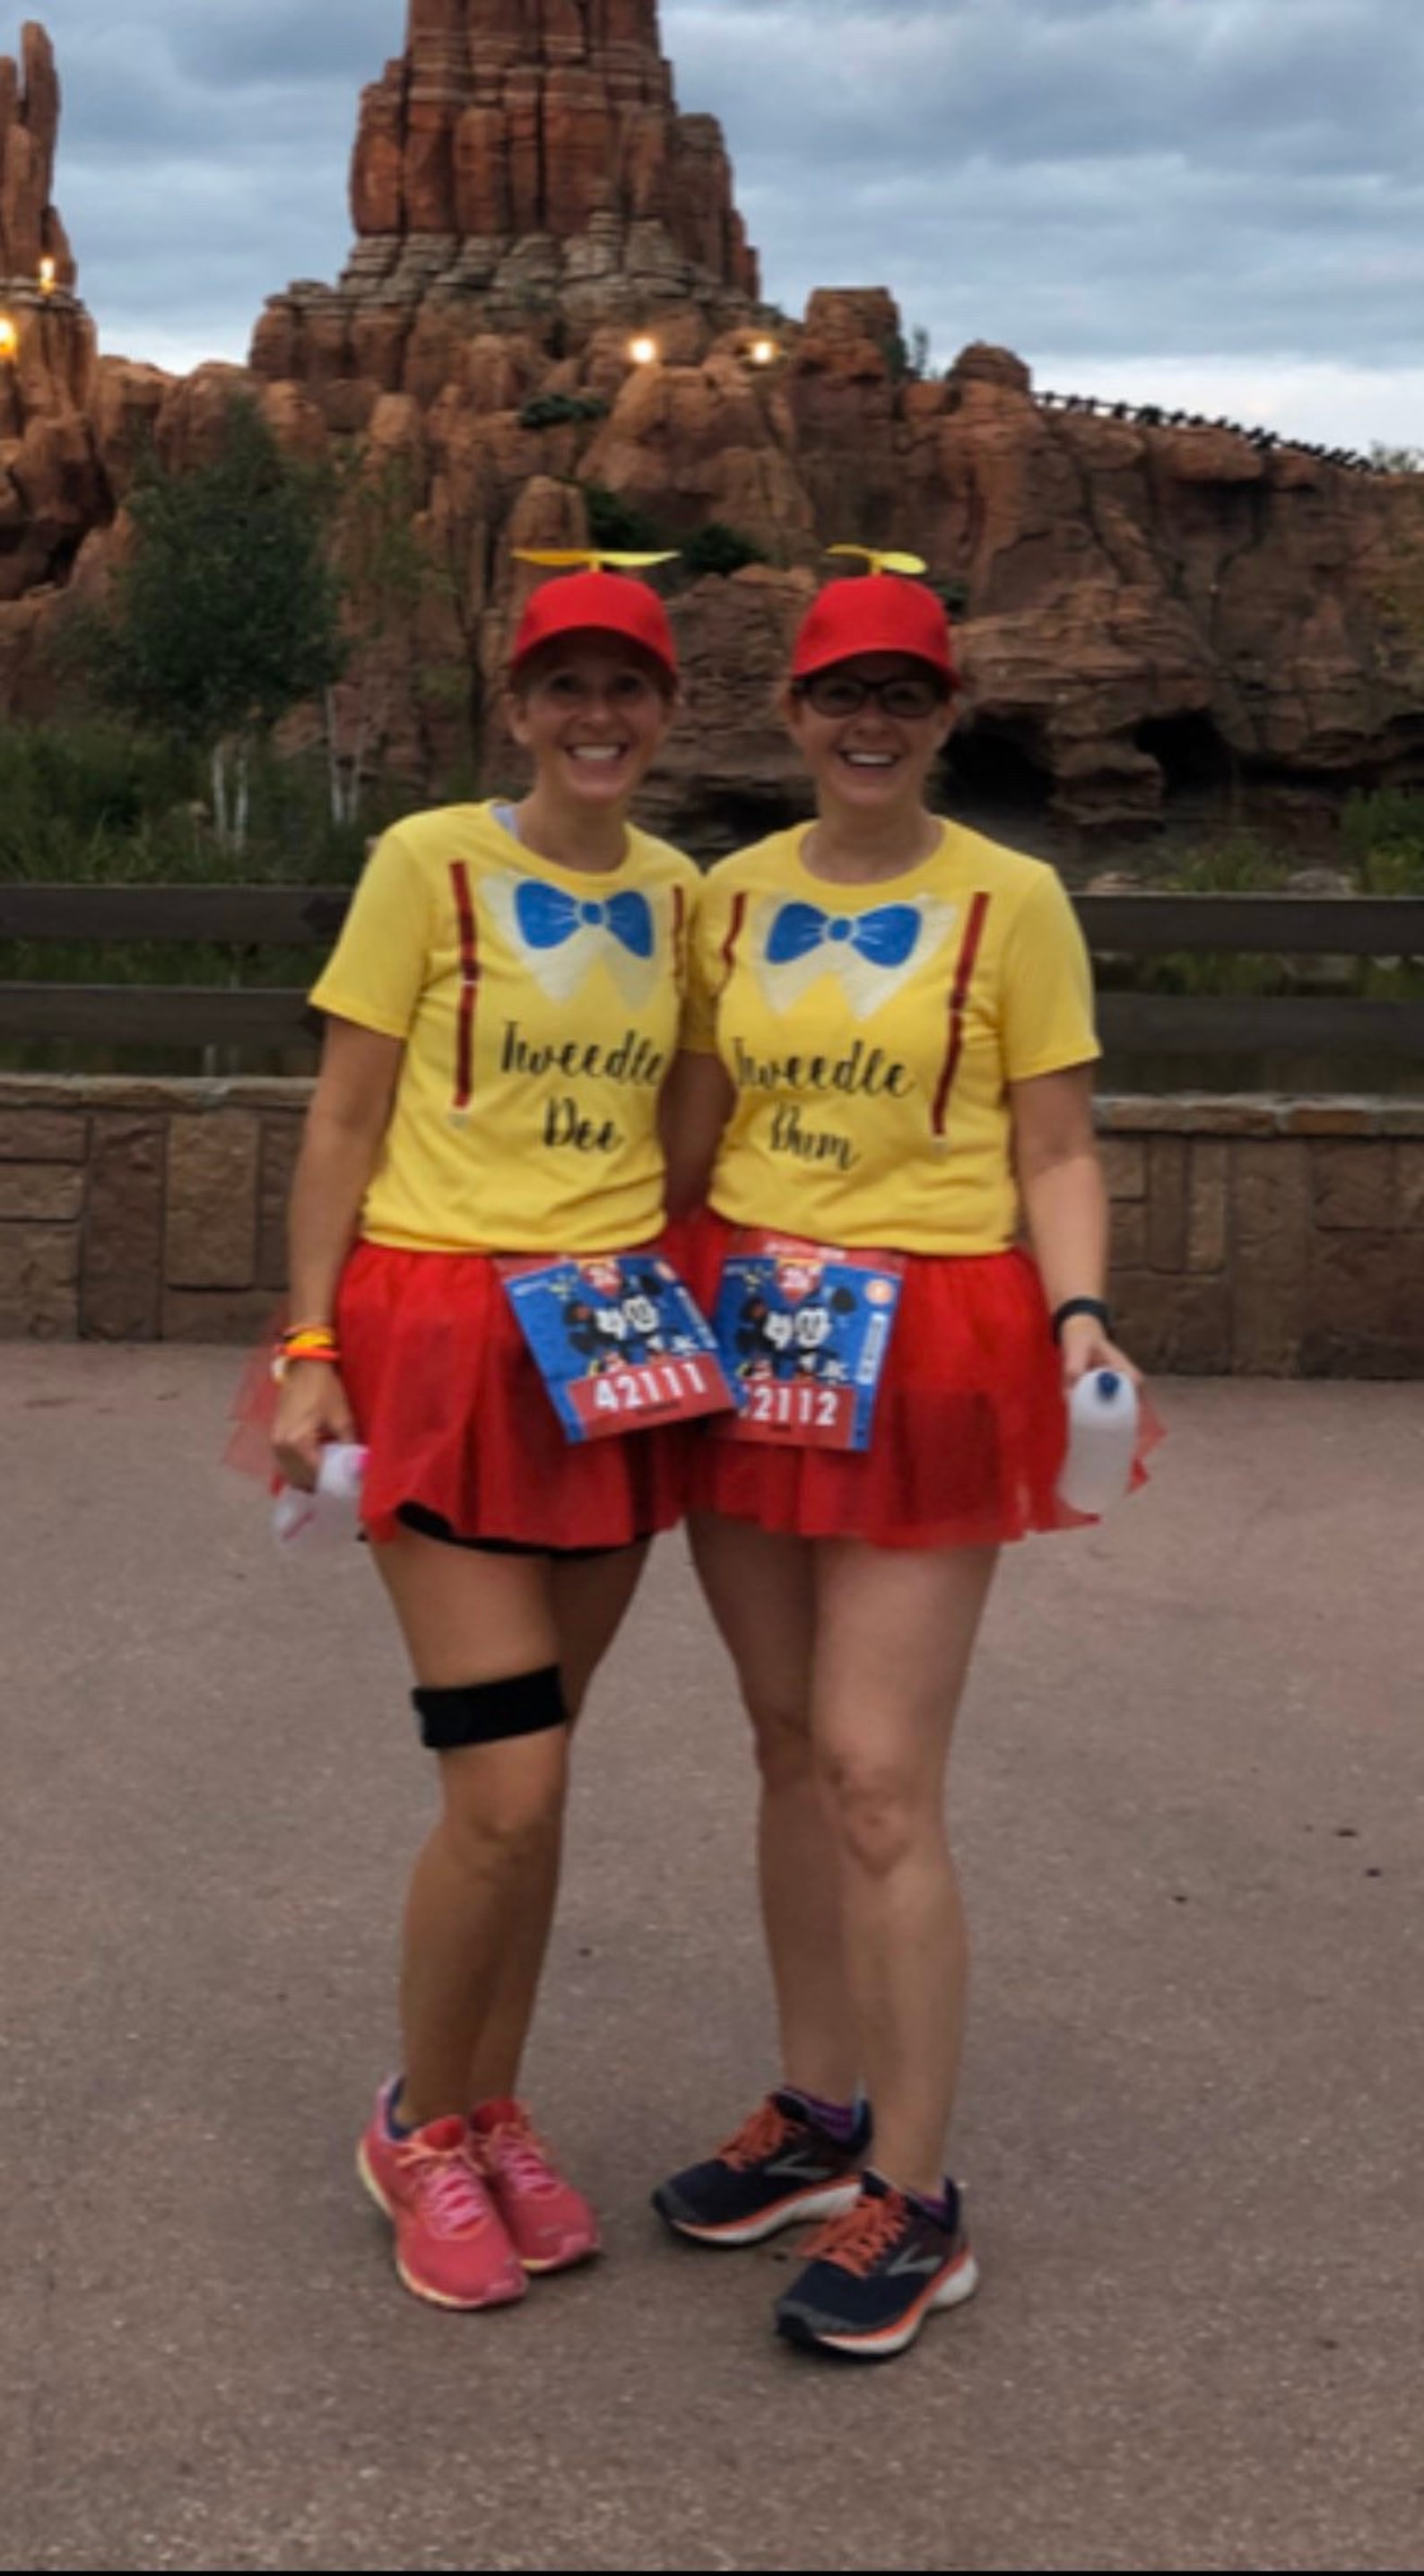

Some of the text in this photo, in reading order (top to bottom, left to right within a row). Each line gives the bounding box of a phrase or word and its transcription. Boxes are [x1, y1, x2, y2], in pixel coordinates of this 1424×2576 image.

[499, 1021, 665, 1087] Tweedle
[731, 1037, 915, 1098] Tweedle
[543, 1096, 621, 1152] Dee
[769, 1103, 860, 1170] Dum
[595, 1362, 706, 1411] 42111
[741, 1385, 838, 1426] 2112
